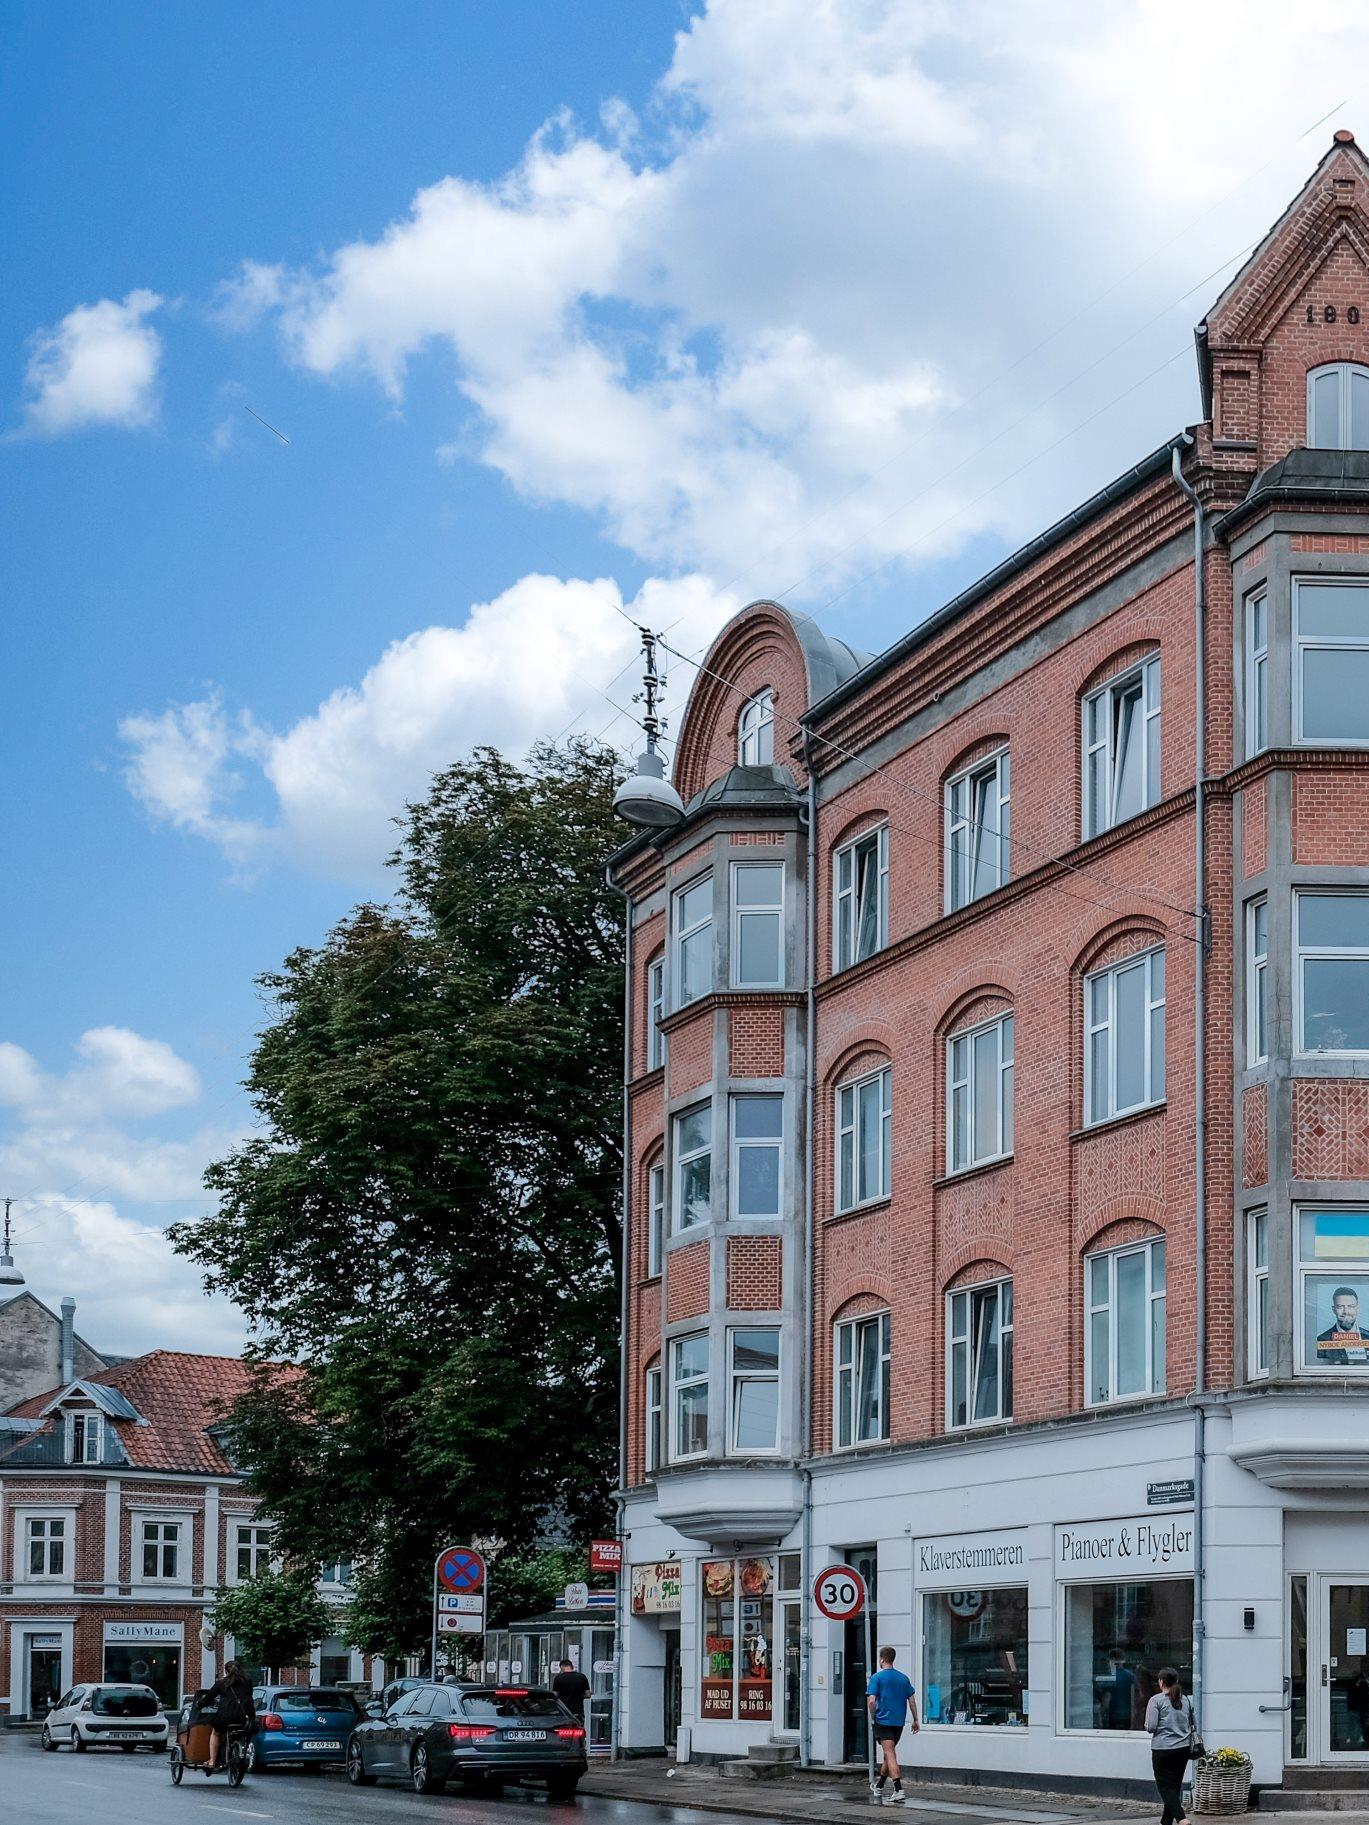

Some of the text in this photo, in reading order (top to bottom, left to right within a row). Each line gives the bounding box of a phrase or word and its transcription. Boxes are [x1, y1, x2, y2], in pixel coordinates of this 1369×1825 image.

[1152, 1481, 1189, 1492] Danmarksgade
[592, 1544, 620, 1552] PIZZA
[1062, 1523, 1192, 1563] Pianoer & Flygler
[599, 1552, 620, 1560] MIX
[920, 1545, 1023, 1572] Klaverstemmeren
[655, 1564, 680, 1583] Pizza
[662, 1581, 680, 1600] Mix
[824, 1583, 855, 1604] 30
[111, 1626, 176, 1639] SallyMane
[706, 1635, 731, 1654] Pizza
[712, 1653, 730, 1673] Mix
[706, 1690, 729, 1699] MAD UD
[748, 1690, 764, 1700] RING
[705, 1700, 731, 1710] AF HUSET
[740, 1701, 772, 1710] 98 16 03 16
[509, 1731, 545, 1739] DR 94 816
